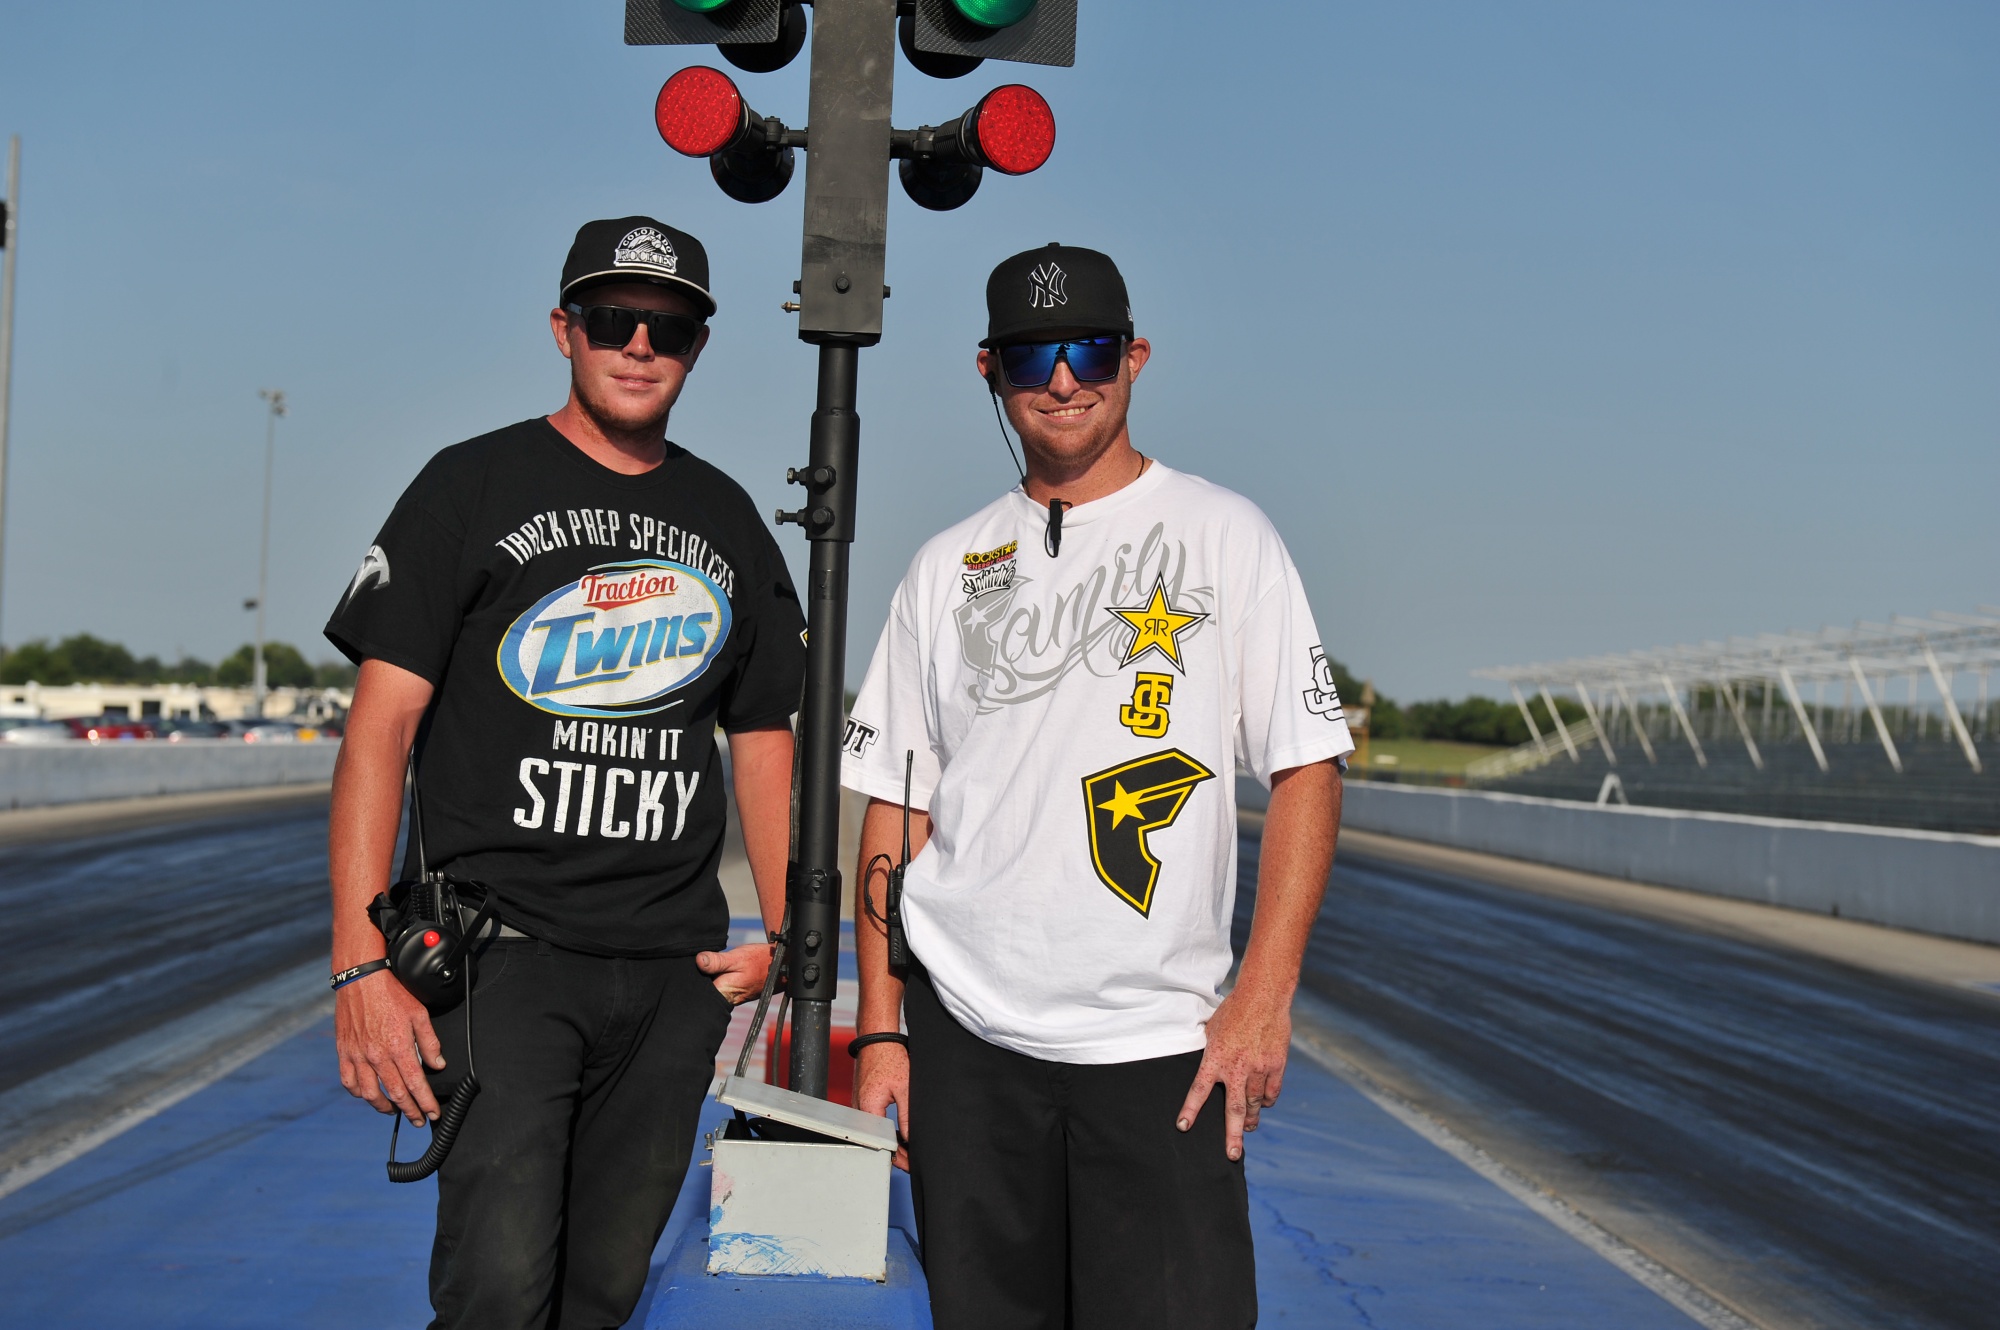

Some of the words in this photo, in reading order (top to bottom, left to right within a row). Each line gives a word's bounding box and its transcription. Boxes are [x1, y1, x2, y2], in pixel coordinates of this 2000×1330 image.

[617, 249, 676, 269] ROCKIES
[622, 228, 672, 253] COLORADO
[1028, 262, 1068, 308] NY
[495, 511, 568, 566] TRACK
[566, 508, 620, 547] PREP
[629, 513, 736, 599] SPECIALISTS
[967, 561, 994, 571] ENERGY
[581, 572, 678, 604] Traction
[527, 611, 713, 698] Twins
[552, 719, 652, 760] MAKIN'
[659, 728, 684, 761] IT
[513, 757, 700, 842] STICKY
